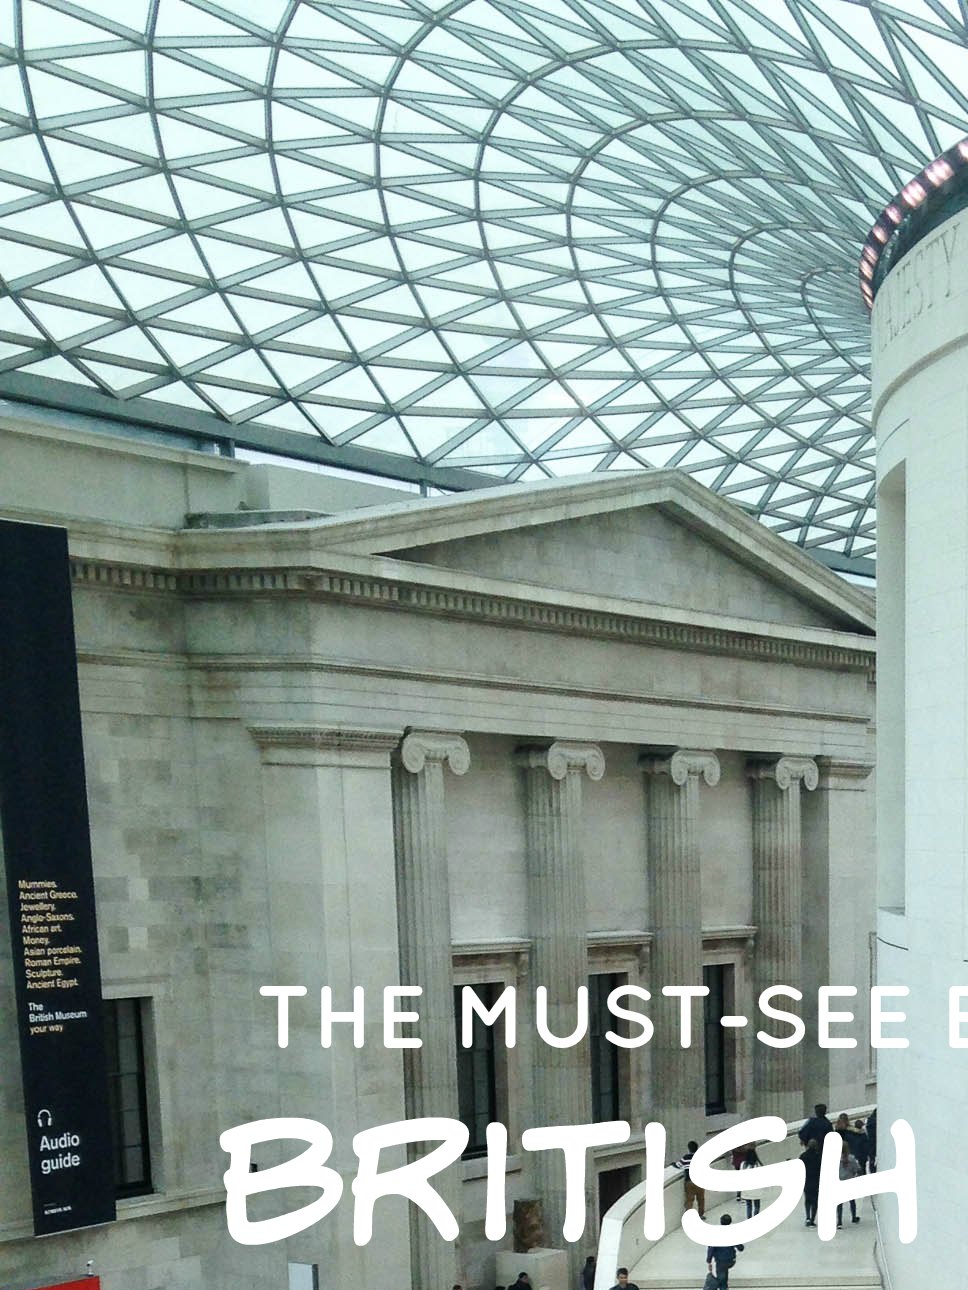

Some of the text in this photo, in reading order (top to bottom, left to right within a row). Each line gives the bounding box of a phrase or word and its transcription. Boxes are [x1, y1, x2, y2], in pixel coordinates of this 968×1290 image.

[18, 880, 57, 889] Mummies.
[19, 890, 78, 900] Ancient Greece.
[21, 913, 75, 923] Anglo-Saxons.
[22, 925, 49, 934] African
[23, 936, 50, 945] Money.
[24, 947, 46, 957] Asian
[25, 957, 81, 967] Roman Empire.
[26, 969, 64, 979] Sculpture.
[27, 980, 55, 990] Ancient
[28, 1003, 44, 1011] The
[29, 1011, 88, 1023] British Museum
[30, 1024, 64, 1036] your way
[40, 1132, 80, 1152] Audio
[41, 1152, 81, 1174] guide
